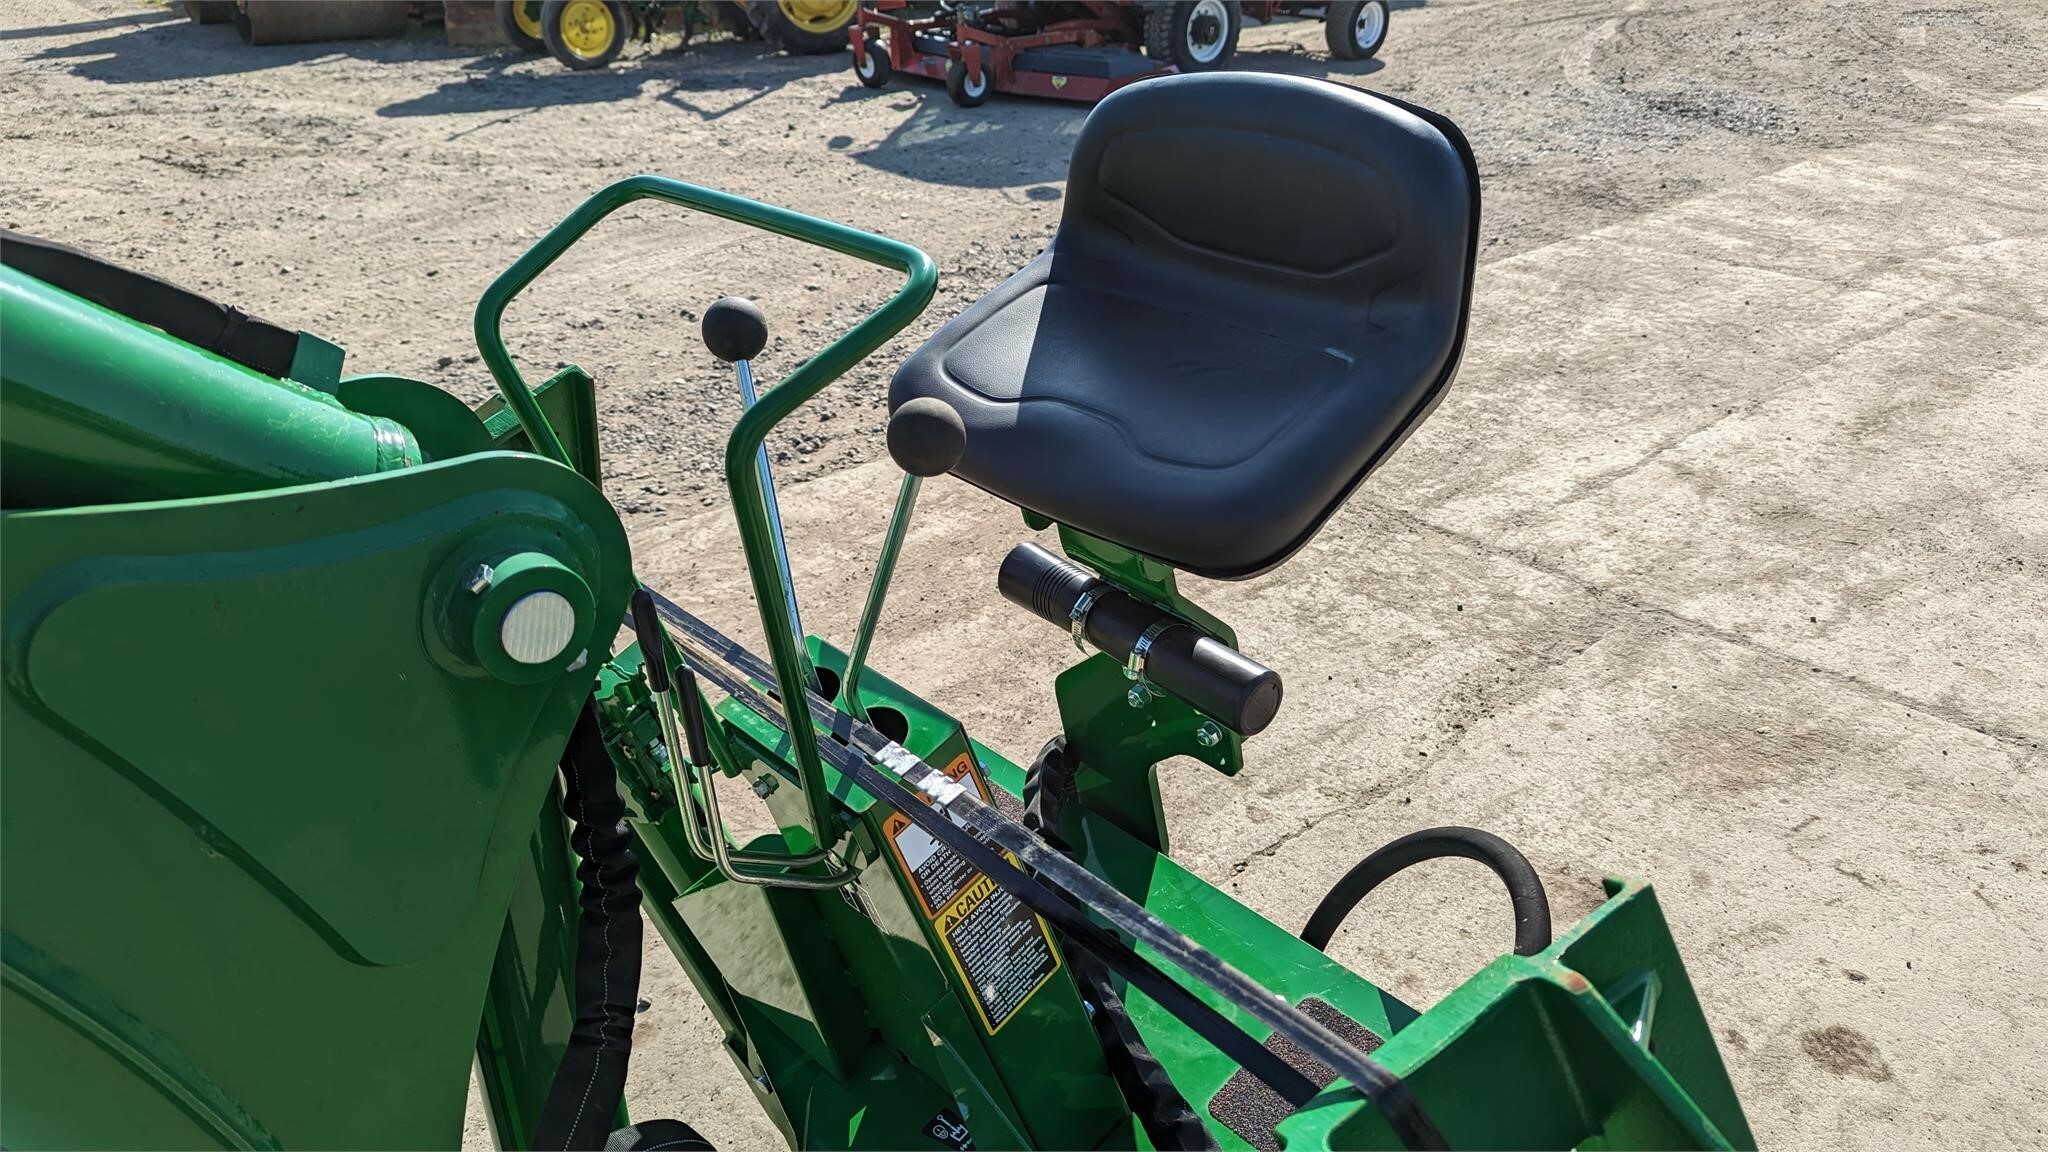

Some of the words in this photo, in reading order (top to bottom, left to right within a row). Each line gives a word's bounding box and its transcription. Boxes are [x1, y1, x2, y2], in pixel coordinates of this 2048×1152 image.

[917, 853, 937, 875] AVOID
[920, 867, 931, 880] OR
[923, 864, 944, 887] Operate
[926, 876, 938, 891] from
[938, 857, 960, 880] backhoe
[928, 880, 943, 896] when
[942, 858, 966, 884] installing
[931, 876, 954, 901] backhoe.
[933, 894, 942, 905] DO
[941, 883, 953, 897] NOT
[935, 897, 946, 910] this
[951, 918, 969, 938] HELP
[969, 897, 990, 921] AVOID
